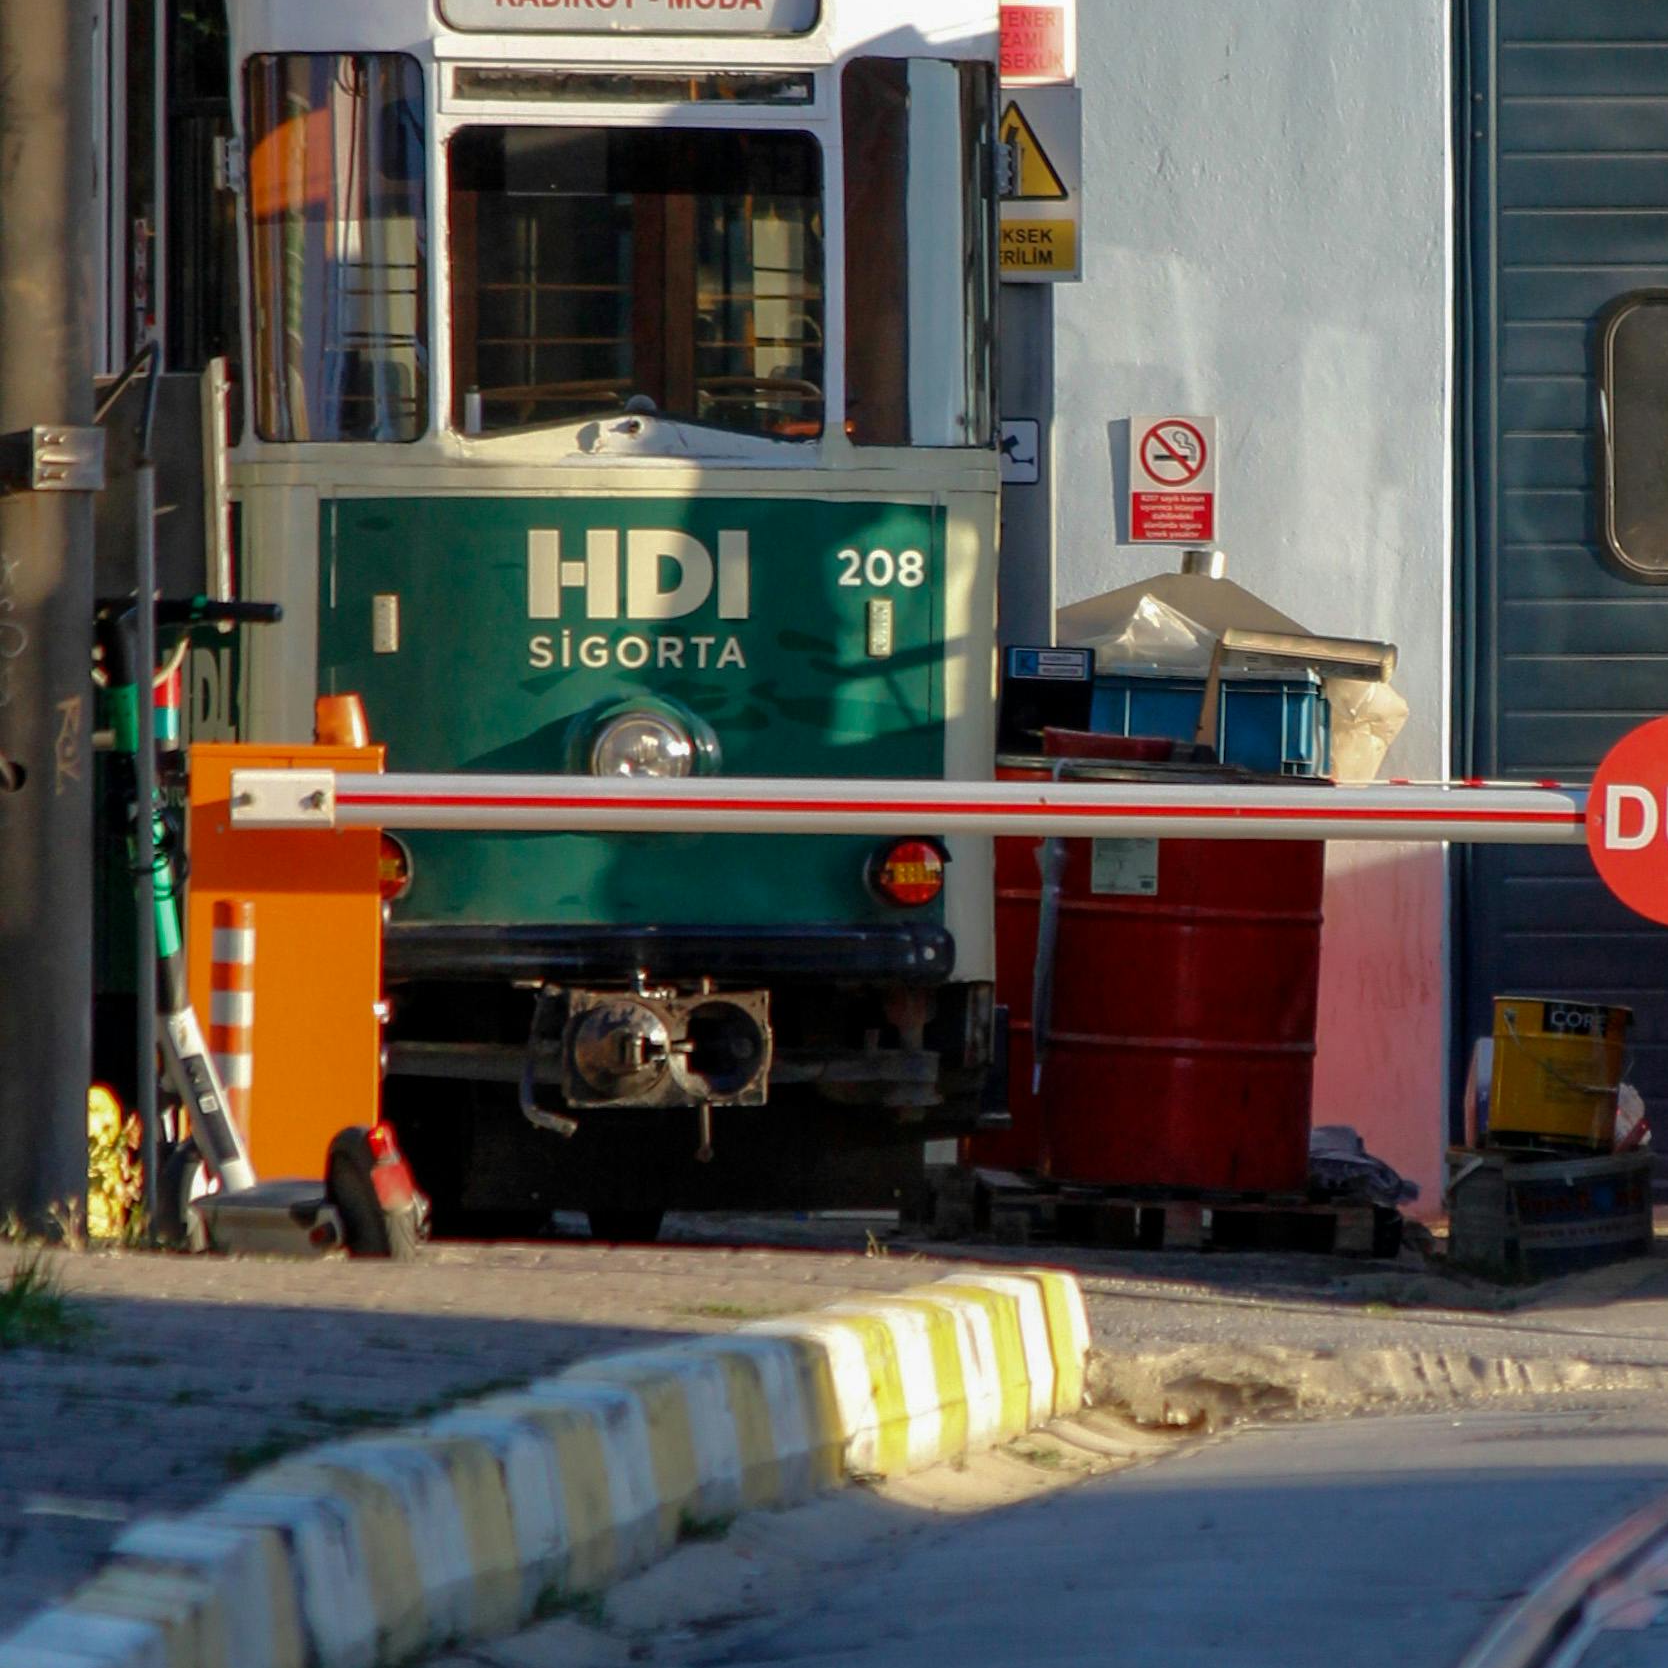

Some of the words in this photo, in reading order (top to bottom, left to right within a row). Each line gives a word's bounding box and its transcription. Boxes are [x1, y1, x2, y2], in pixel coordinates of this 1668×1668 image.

[1002, 228, 1053, 243] KSEK
[1000, 247, 1053, 265] RİLİM
[528, 529, 750, 620] HDI
[836, 548, 925, 587] 208
